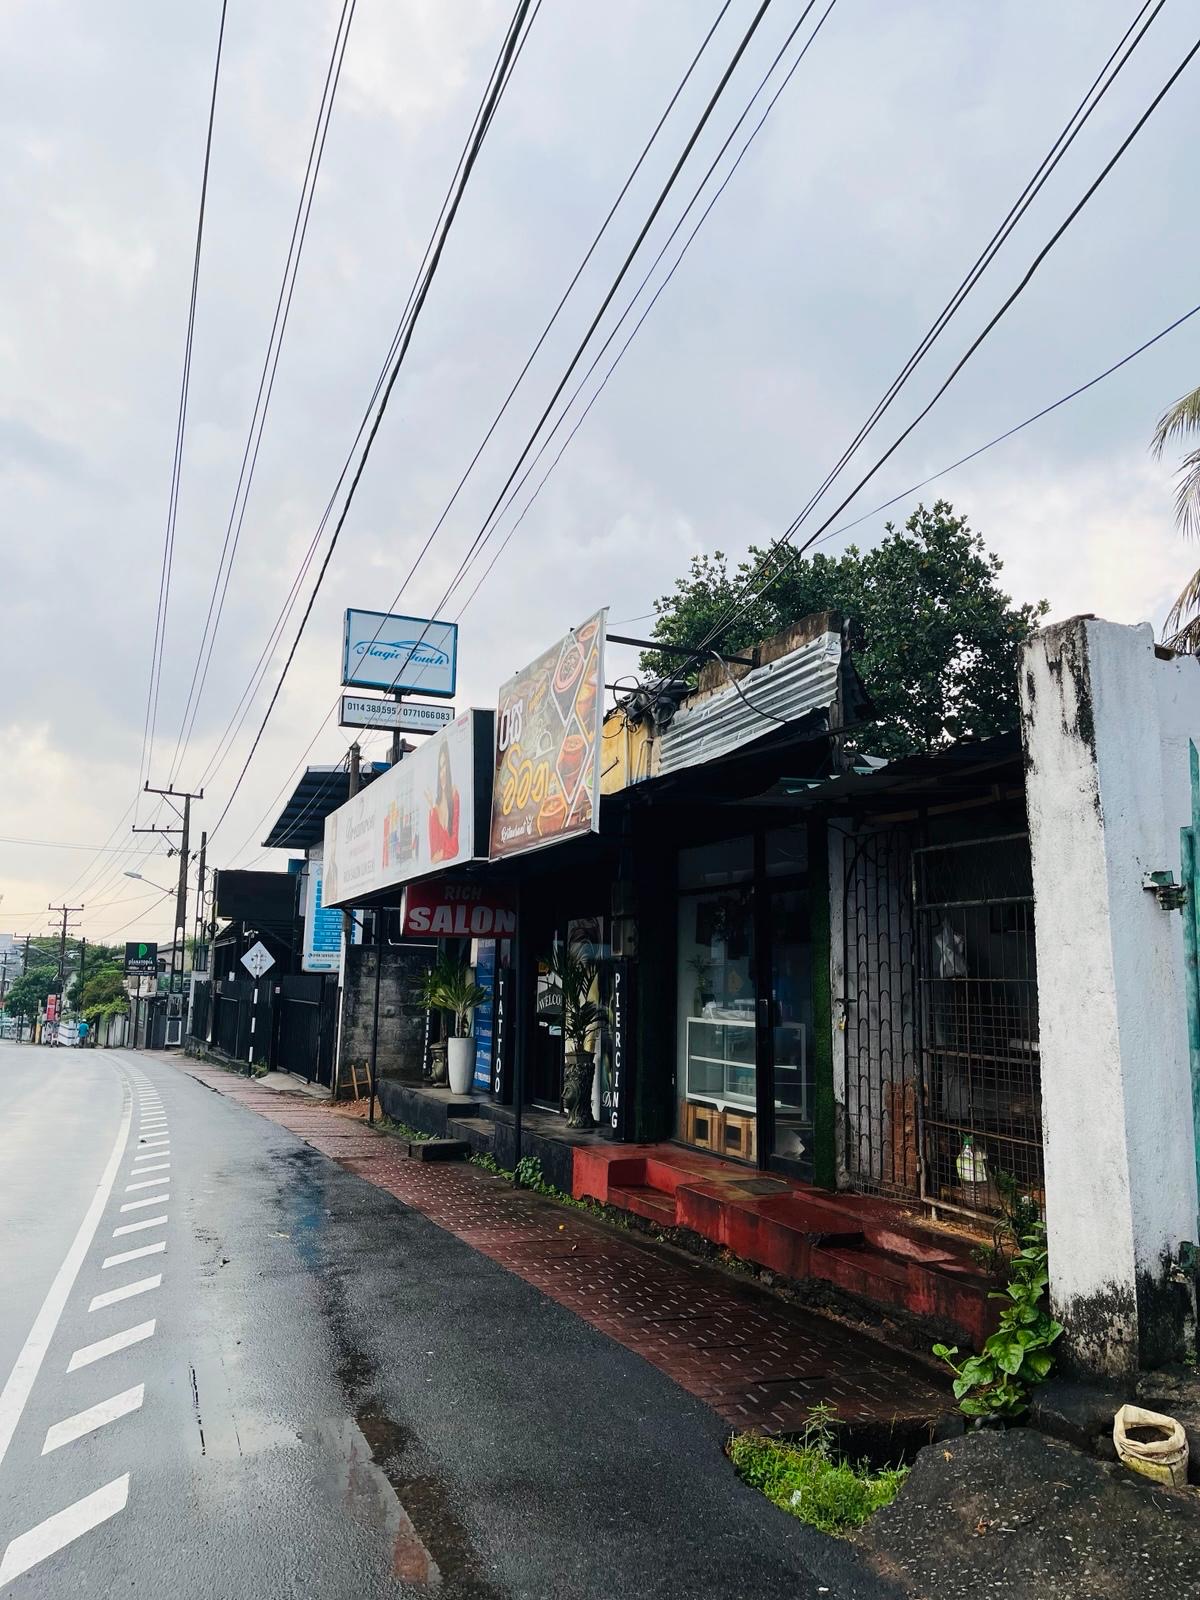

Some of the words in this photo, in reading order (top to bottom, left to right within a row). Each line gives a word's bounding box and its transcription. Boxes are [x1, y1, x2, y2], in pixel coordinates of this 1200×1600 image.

[356, 645, 401, 662] Magic
[406, 650, 444, 666] Touch
[444, 885, 482, 900] RICH
[408, 904, 516, 934] SALON
[539, 993, 563, 1011] WELCO
[494, 981, 504, 1093] TATTOO
[611, 972, 622, 1129] PIERCING
